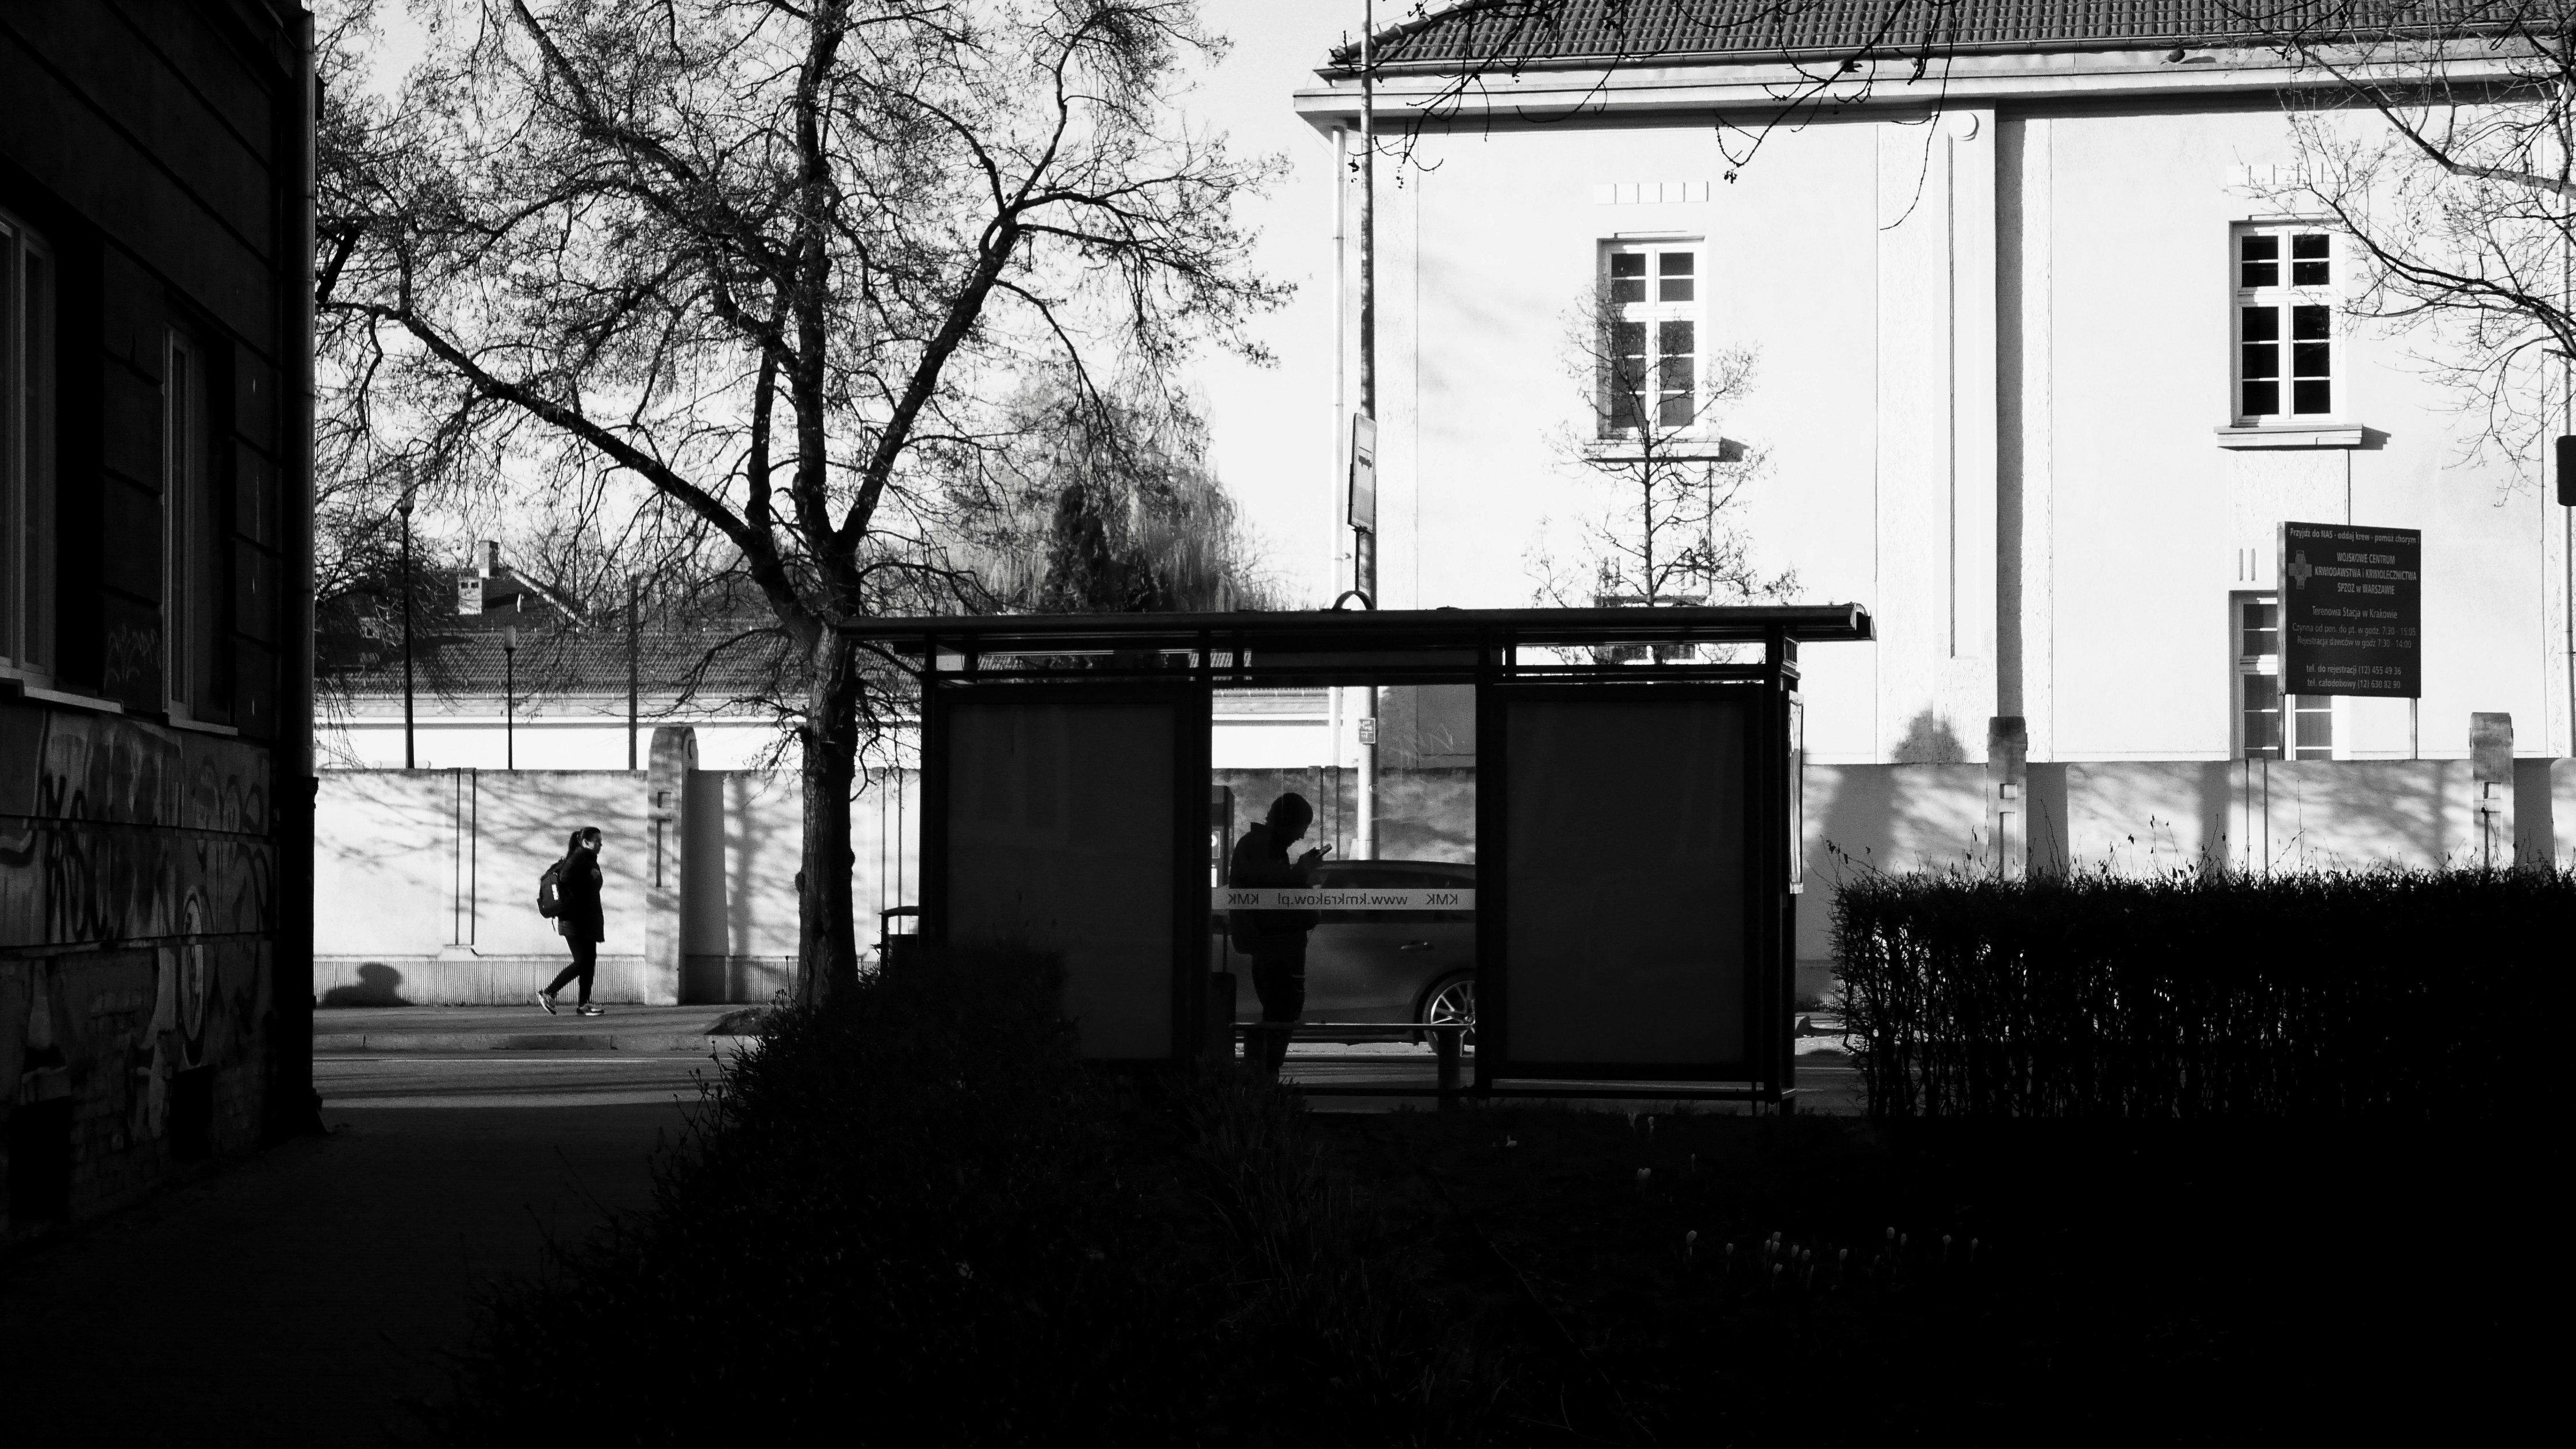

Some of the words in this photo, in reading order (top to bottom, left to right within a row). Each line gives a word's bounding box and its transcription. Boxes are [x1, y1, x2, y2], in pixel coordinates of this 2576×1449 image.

[2312, 528, 2320, 538] do
[2321, 530, 2333, 539] NAS
[2337, 531, 2355, 542] oddaj
[2355, 532, 2370, 541] krew
[2375, 534, 2394, 543] pomóż
[2395, 534, 2416, 545] chorym
[2337, 552, 2368, 563] WOJSKOWE
[2369, 554, 2395, 565] CENTRUM
[2314, 566, 2361, 578] KRWIODAWSTWA
[2365, 569, 2417, 581] KRWIOLECZNICTWA
[2337, 582, 2355, 593] SPZOZ
[2362, 584, 2395, 595] WARSZAWIE
[2312, 605, 2341, 617] Terenowa
[2343, 607, 2361, 620] Stacja
[2370, 608, 2398, 619] Krakowie
[2292, 623, 2314, 633] Czynna
[2315, 624, 2323, 632] od
[2339, 624, 2347, 633] do
[2297, 635, 2328, 647] Rejestracja
[2329, 637, 2354, 646] dawców
[2354, 639, 2360, 647] w
[2306, 664, 2316, 673] tel.
[2317, 663, 2326, 673] do
[2327, 664, 2357, 676] rejestracji
[2358, 665, 2371, 676] (12)
[2372, 666, 2383, 674] 455
[2385, 666, 2392, 675] 49
[2394, 666, 2402, 676] 36
[2307, 677, 2317, 687] tel.
[2318, 678, 2356, 689] całodobowy
[2358, 679, 2370, 689] (12)
[2371, 680, 2382, 688] 630
[2384, 680, 2391, 689] 82
[2393, 680, 2401, 689] 90
